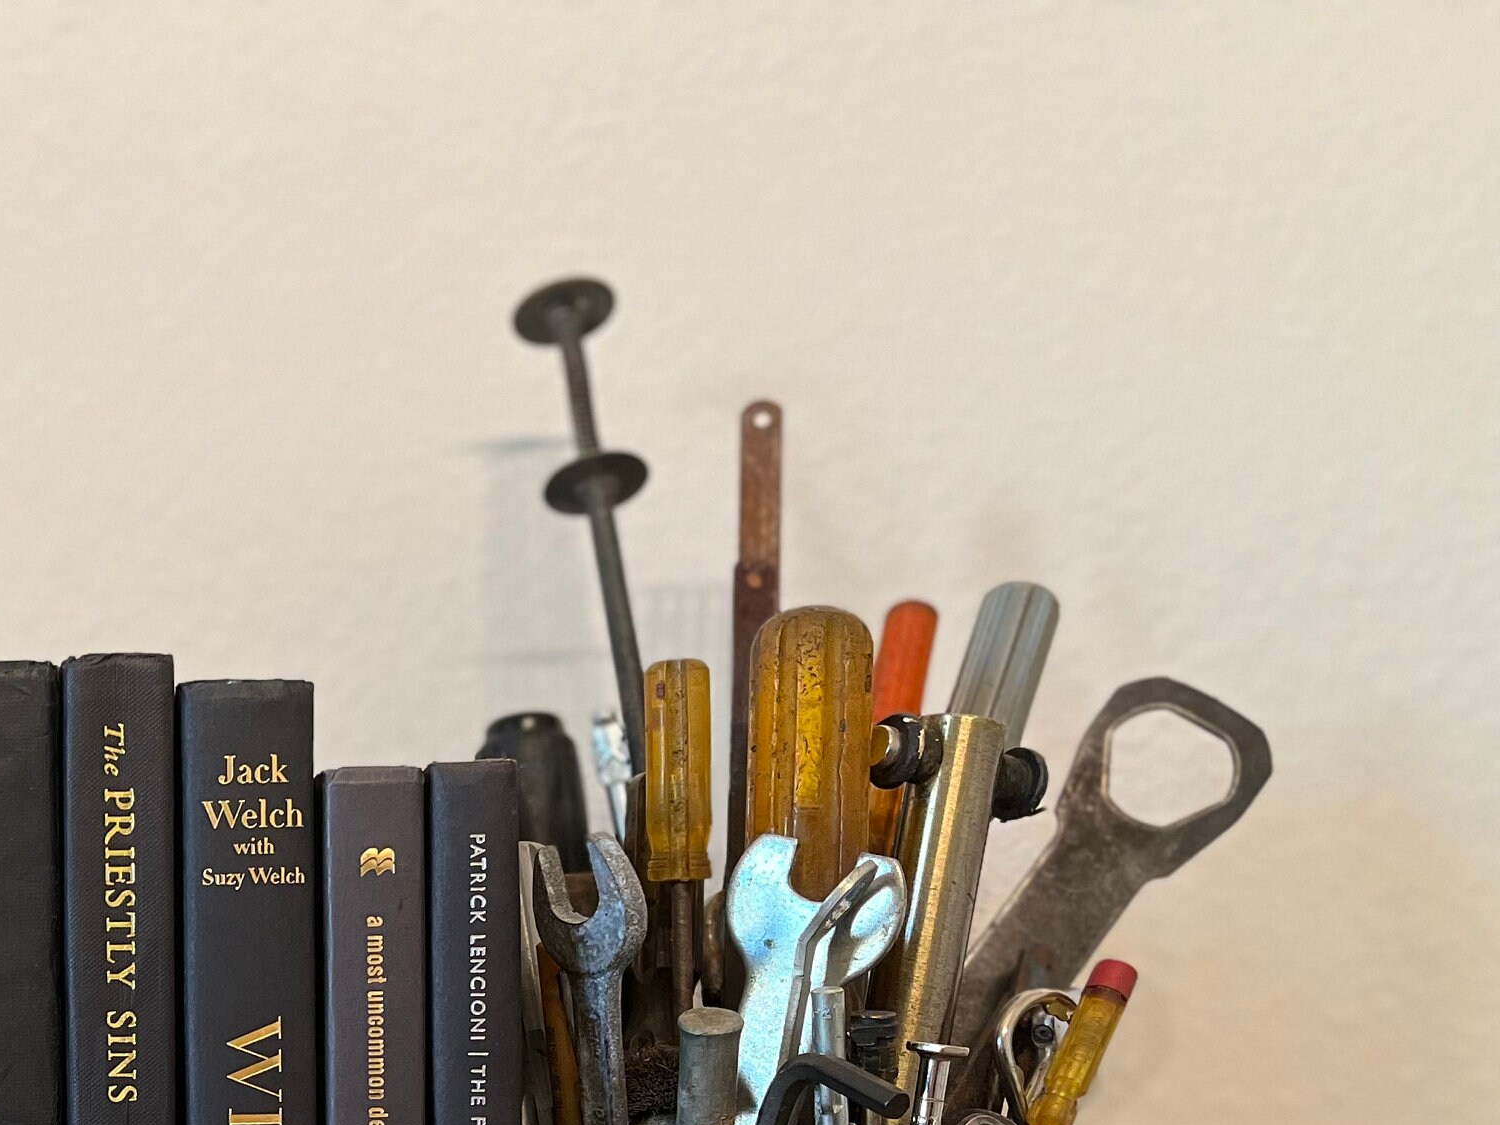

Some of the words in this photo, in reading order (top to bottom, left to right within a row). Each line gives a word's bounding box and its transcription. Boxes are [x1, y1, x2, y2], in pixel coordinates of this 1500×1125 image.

[104, 723, 125, 776] The
[218, 754, 289, 784] Jack
[201, 799, 303, 829] Welch
[234, 837, 274, 854] with
[104, 788, 135, 990] PRIESTLY
[202, 868, 245, 890] Suzy
[248, 867, 304, 884] Welch
[470, 834, 486, 923] PATRICK
[366, 916, 384, 928] a
[367, 936, 386, 983] most
[470, 935, 486, 1040] LENCIONI
[107, 1011, 137, 1102] SINS
[368, 991, 384, 1099] uncommon
[471, 1065, 486, 1105] THE
